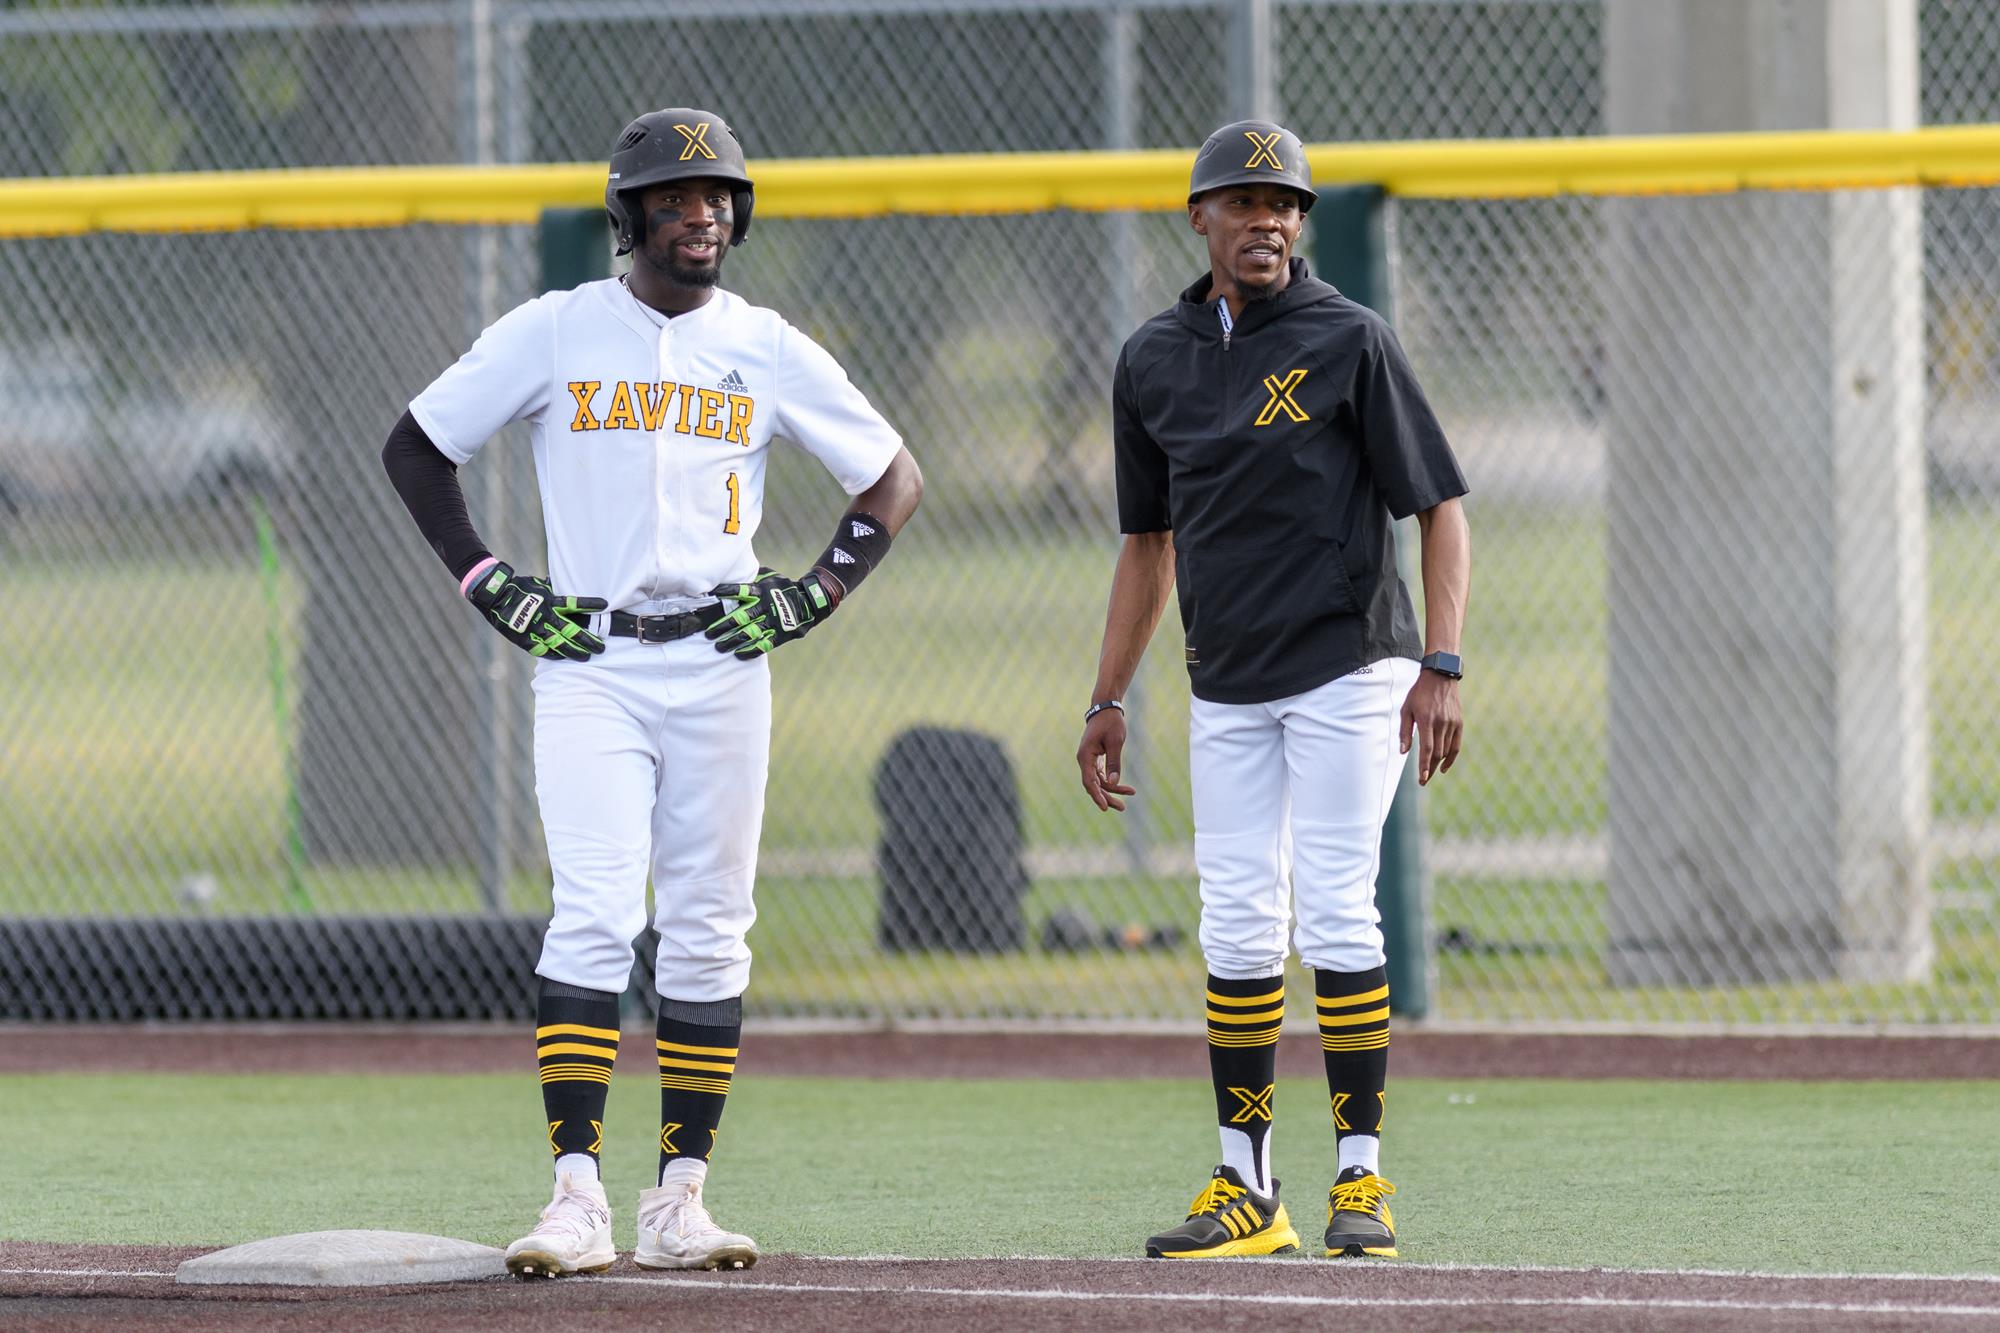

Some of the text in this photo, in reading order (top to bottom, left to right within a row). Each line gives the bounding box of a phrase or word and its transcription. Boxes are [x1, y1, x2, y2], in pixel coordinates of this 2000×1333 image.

[672, 123, 718, 160] X
[1244, 131, 1284, 171] X
[717, 382, 749, 393] adidas
[1254, 369, 1311, 426] X
[567, 381, 755, 447] XAVIER
[723, 472, 741, 535] 1
[850, 520, 876, 535] adidas
[833, 547, 856, 564] adidas
[1227, 1083, 1275, 1123] X
